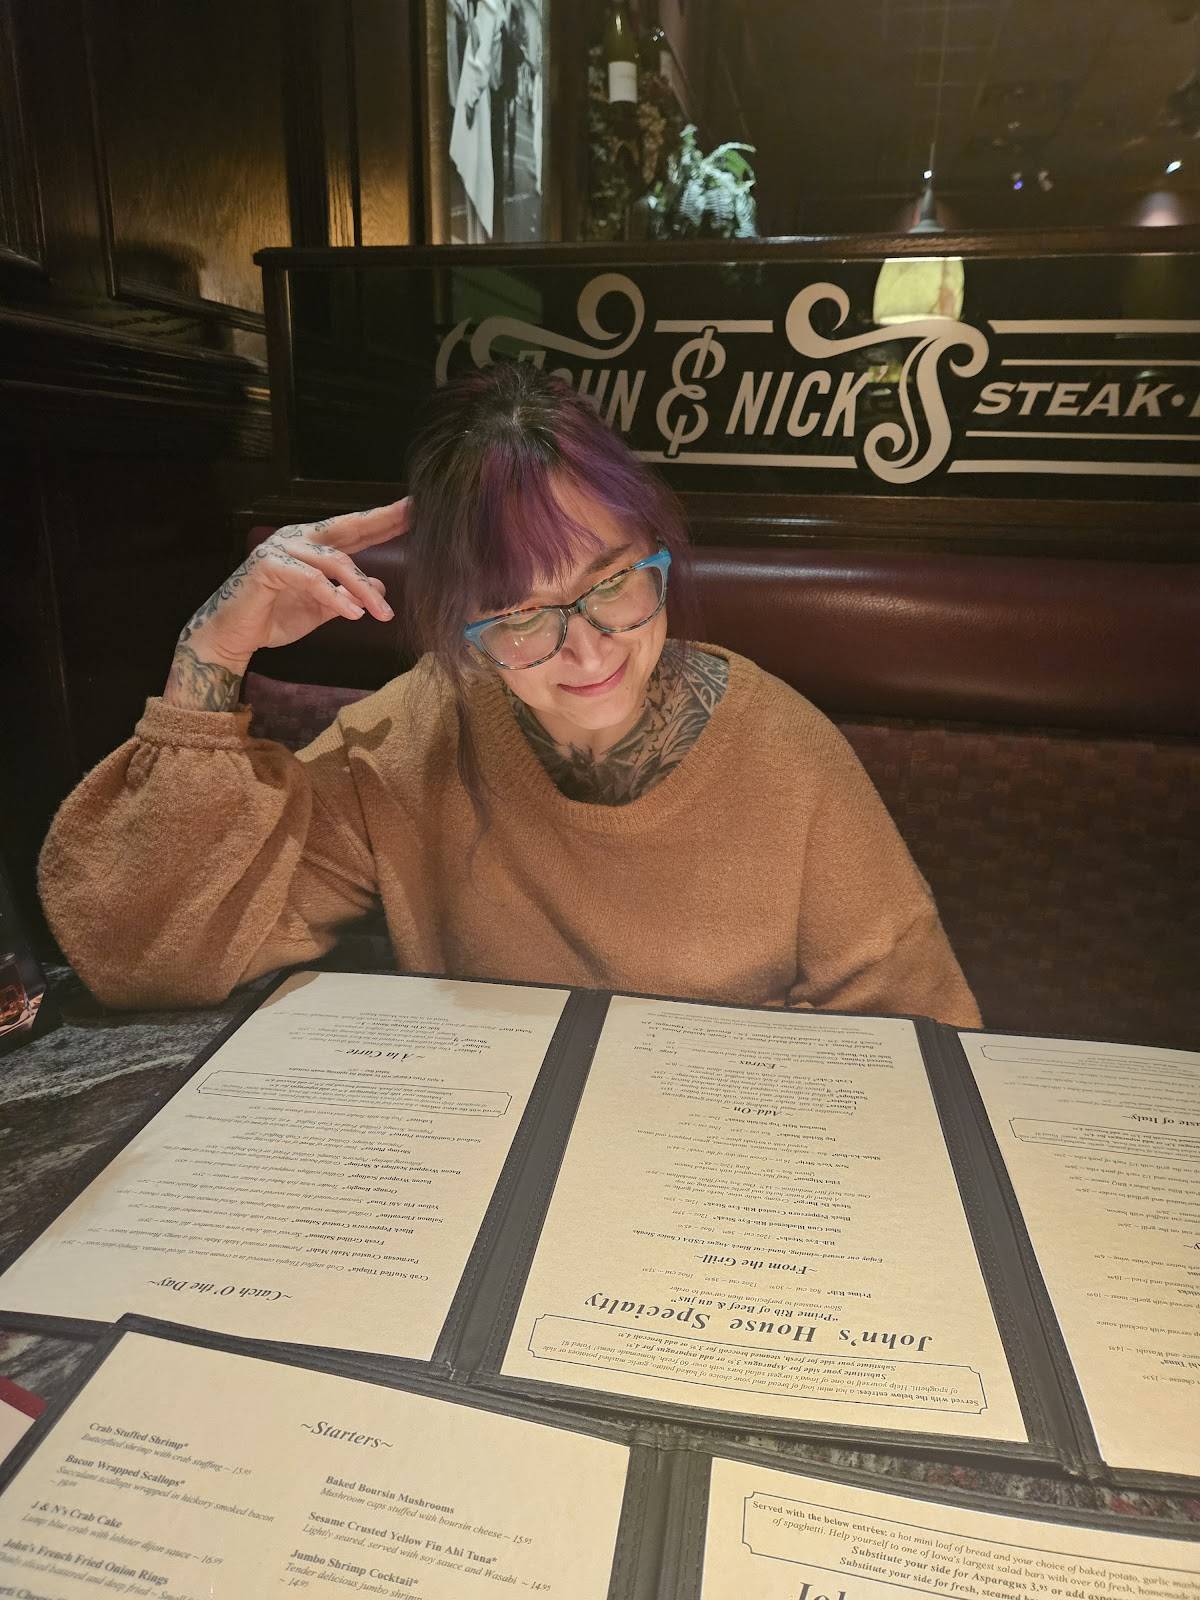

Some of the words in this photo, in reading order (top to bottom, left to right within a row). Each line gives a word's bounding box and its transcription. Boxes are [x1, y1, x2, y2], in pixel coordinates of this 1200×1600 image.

[656, 327, 726, 458] &
[726, 282, 989, 484] NICK'S
[345, 1048, 381, 1056] Carte
[585, 1292, 710, 1329] Specialty
[717, 1301, 726, 1309] &
[727, 1301, 754, 1313] Beef
[758, 1305, 770, 1314] of
[774, 1309, 792, 1317] Rib
[729, 1318, 816, 1342] House
[39, 1503, 49, 1511] &
[320, 1487, 365, 1504] Mushroom
[366, 1500, 387, 1512] caps
[387, 1505, 418, 1518] stuffed
[418, 1512, 437, 1522] with
[438, 1515, 471, 1530] boursin
[472, 1525, 502, 1538] cheese
[325, 1475, 356, 1489] Baked
[357, 1483, 395, 1499] Boursin
[397, 1492, 454, 1514] Mushrooms
[308, 1511, 344, 1527] Sesame
[347, 1521, 387, 1537] Crusted
[391, 1531, 421, 1545] Yellow
[424, 1540, 441, 1551] Fin
[444, 1545, 464, 1556] Ahi
[752, 1500, 782, 1513] Served
[785, 1508, 804, 1518] with
[808, 1512, 821, 1521] the
[824, 1515, 849, 1527] below
[897, 1531, 911, 1541] hot
[913, 1537, 932, 1546] mini
[935, 1539, 953, 1552] loaf
[954, 1544, 964, 1554] of
[965, 1545, 991, 1557] bread
[993, 1553, 1010, 1561] and
[1012, 1557, 1032, 1565] your
[1035, 1559, 1064, 1571] choice
[1067, 1564, 1076, 1574] of
[1078, 1565, 1106, 1576] baked
[1108, 1571, 1139, 1582] potato,
[290, 1549, 325, 1564] Jumbo
[326, 1557, 366, 1576] Shrimp
[302, 1523, 333, 1539] Lightly
[367, 1542, 399, 1553] served
[399, 1549, 418, 1559] with
[419, 1555, 436, 1564] soy
[434, 1554, 463, 1570] sauce
[464, 1566, 483, 1575] and
[484, 1568, 517, 1584] Wasabi
[772, 1517, 782, 1526] of
[783, 1520, 825, 1534] spaghetti.
[828, 1528, 850, 1540] Help
[851, 1535, 889, 1549] yourself
[890, 1542, 898, 1550] to
[901, 1546, 917, 1554] one
[919, 1549, 930, 1558] of
[962, 1556, 994, 1570] largest
[996, 1565, 1022, 1575] salad
[1024, 1568, 1044, 1579] bars
[1047, 1574, 1067, 1583] with
[1070, 1578, 1091, 1586] over
[1093, 1580, 1105, 1588] 60
[1107, 1581, 1135, 1594] fresh,
[851, 1545, 902, 1564] Substitute
[903, 1559, 928, 1569] your
[930, 1563, 950, 1574] side
[952, 1567, 968, 1578] for
[971, 1572, 1026, 1589] Asparagus
[1065, 1589, 1084, 1598] add
[839, 1556, 886, 1574] Substitute
[888, 1569, 910, 1579] your
[913, 1574, 931, 1584] side
[933, 1578, 948, 1587] for
[950, 1581, 978, 1595] fresh,
